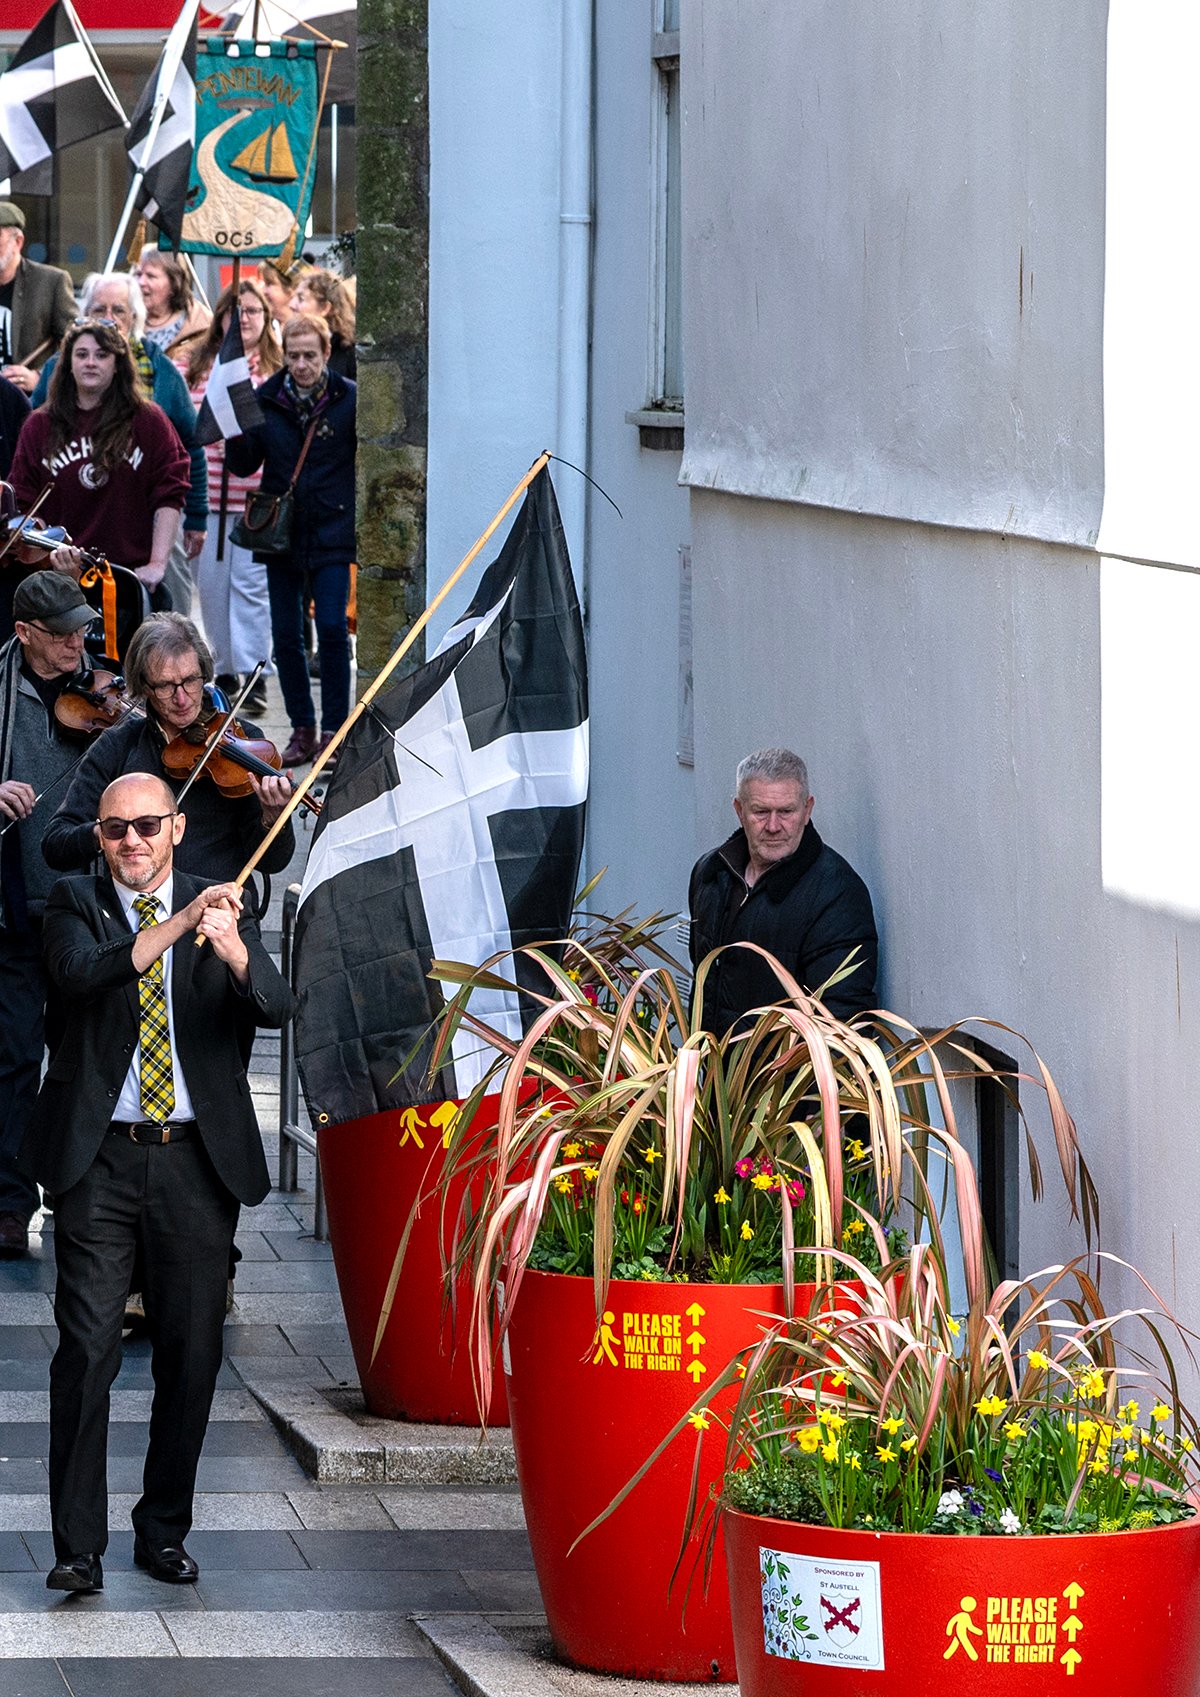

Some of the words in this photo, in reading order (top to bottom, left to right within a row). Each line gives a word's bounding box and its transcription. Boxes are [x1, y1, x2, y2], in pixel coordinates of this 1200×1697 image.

[195, 66, 302, 108] PENTEWAN
[215, 231, 253, 247] OCS
[623, 1312, 681, 1337] PLEASE
[623, 1335, 659, 1354] WALK
[663, 1337, 681, 1354] ON
[624, 1353, 643, 1369] THE
[647, 1354, 681, 1371] RIGHT
[986, 1597, 1057, 1623] PLEASE
[986, 1623, 1030, 1644] WALK
[1035, 1623, 1057, 1644] ON
[986, 1644, 1010, 1662] THE
[1014, 1644, 1056, 1663] RIGHT
